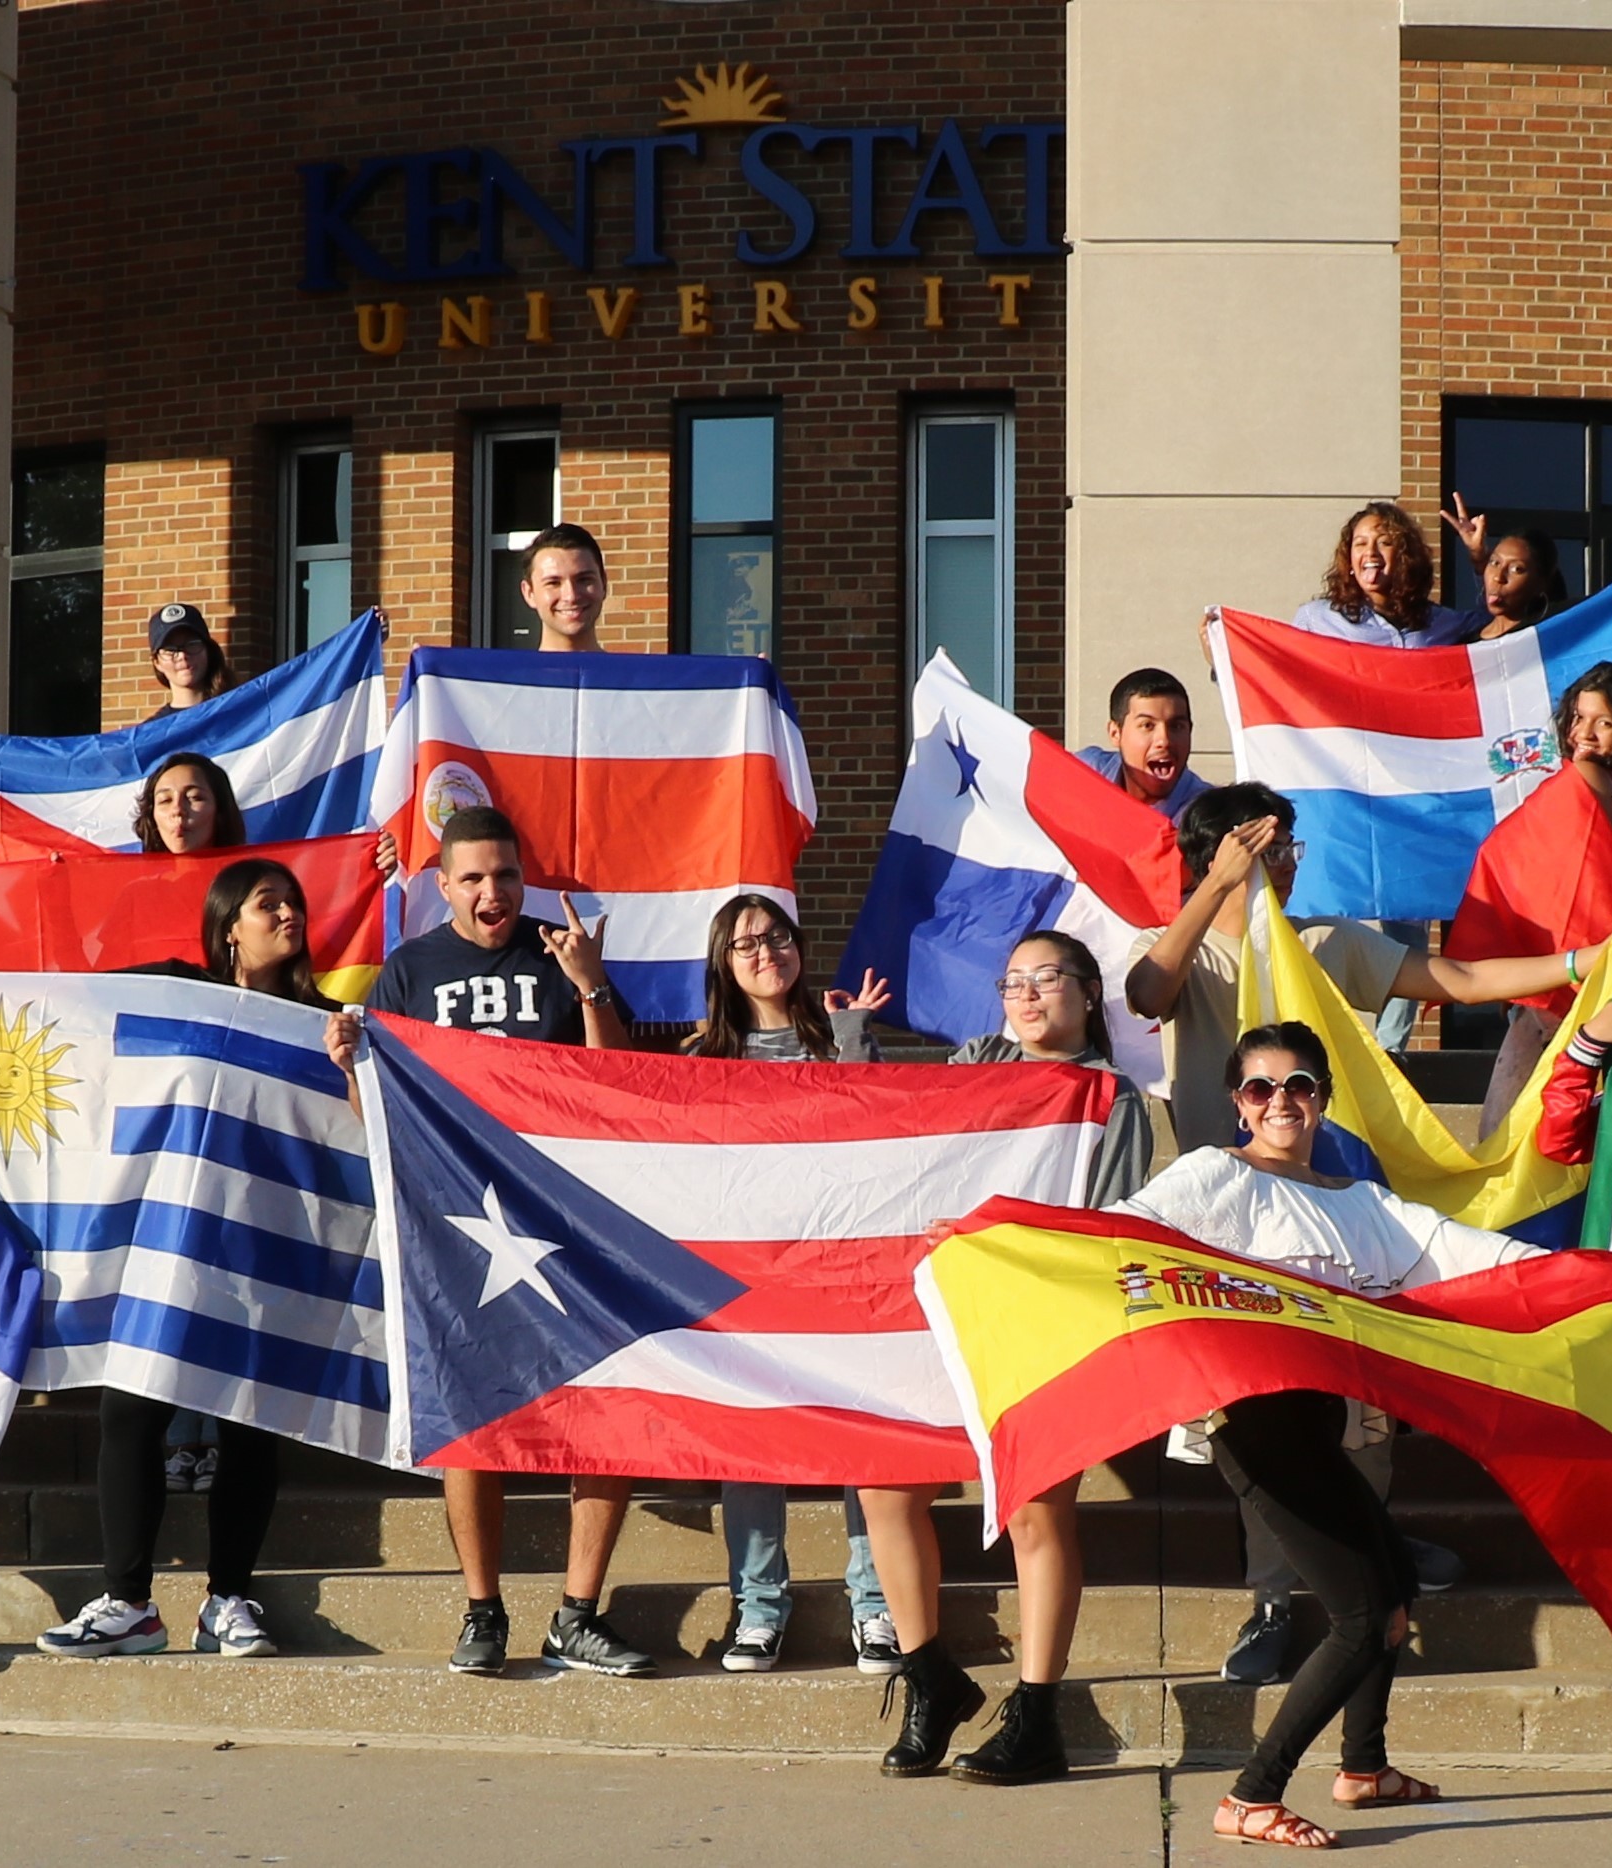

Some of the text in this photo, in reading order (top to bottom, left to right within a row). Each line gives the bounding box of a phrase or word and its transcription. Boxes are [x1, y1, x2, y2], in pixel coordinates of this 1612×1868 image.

[296, 116, 1067, 291] KENT STAT
[354, 274, 1031, 357] UNIVERSIT
[434, 974, 540, 1027] FBI
